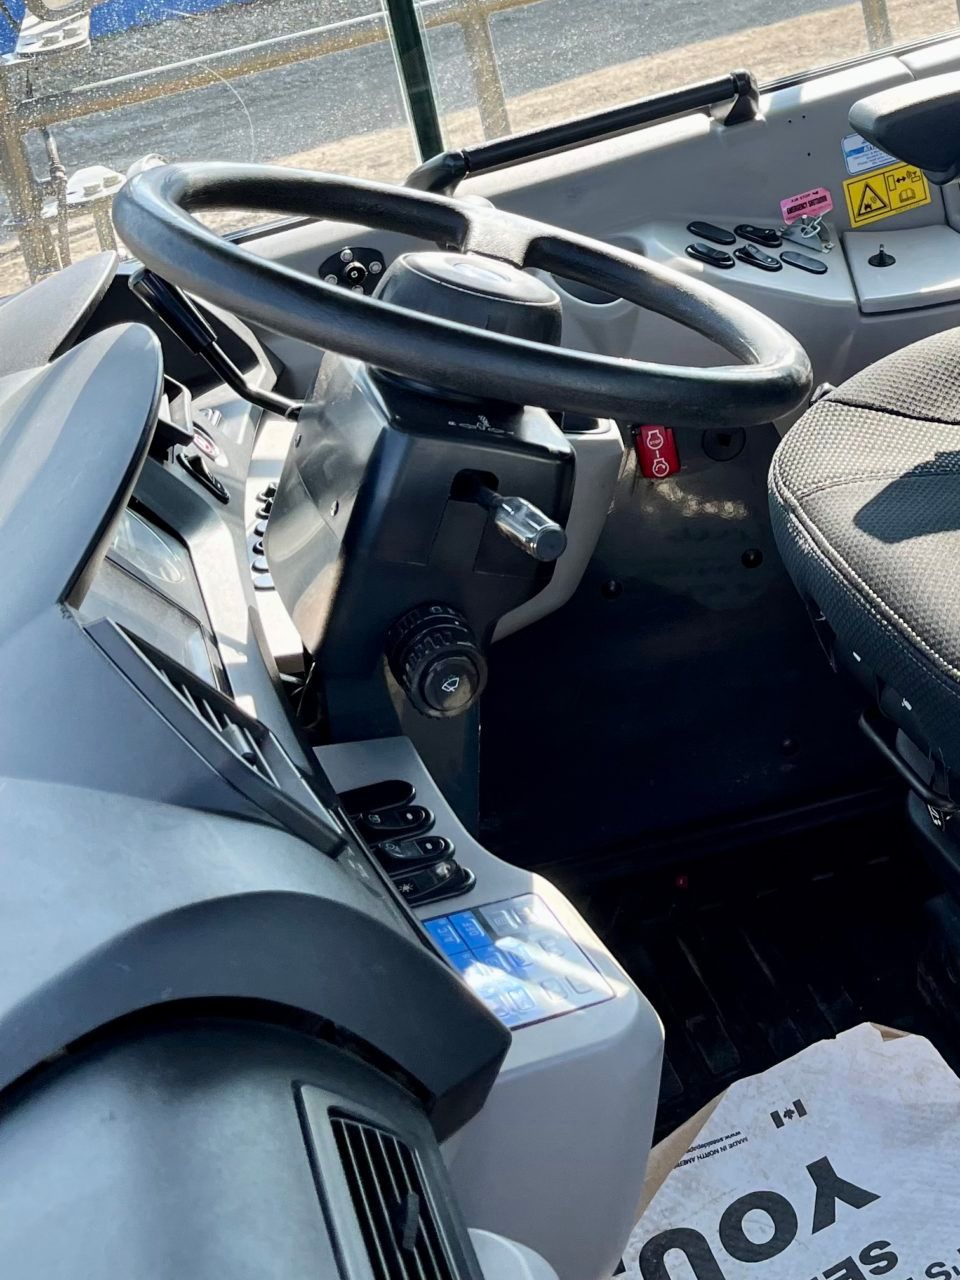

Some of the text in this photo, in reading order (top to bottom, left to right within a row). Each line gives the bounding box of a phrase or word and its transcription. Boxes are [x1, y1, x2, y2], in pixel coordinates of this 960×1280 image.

[462, 921, 481, 937] OFF
[720, 1145, 728, 1153] IN
[728, 1136, 749, 1150] MADE
[696, 1148, 720, 1161] NORTH
